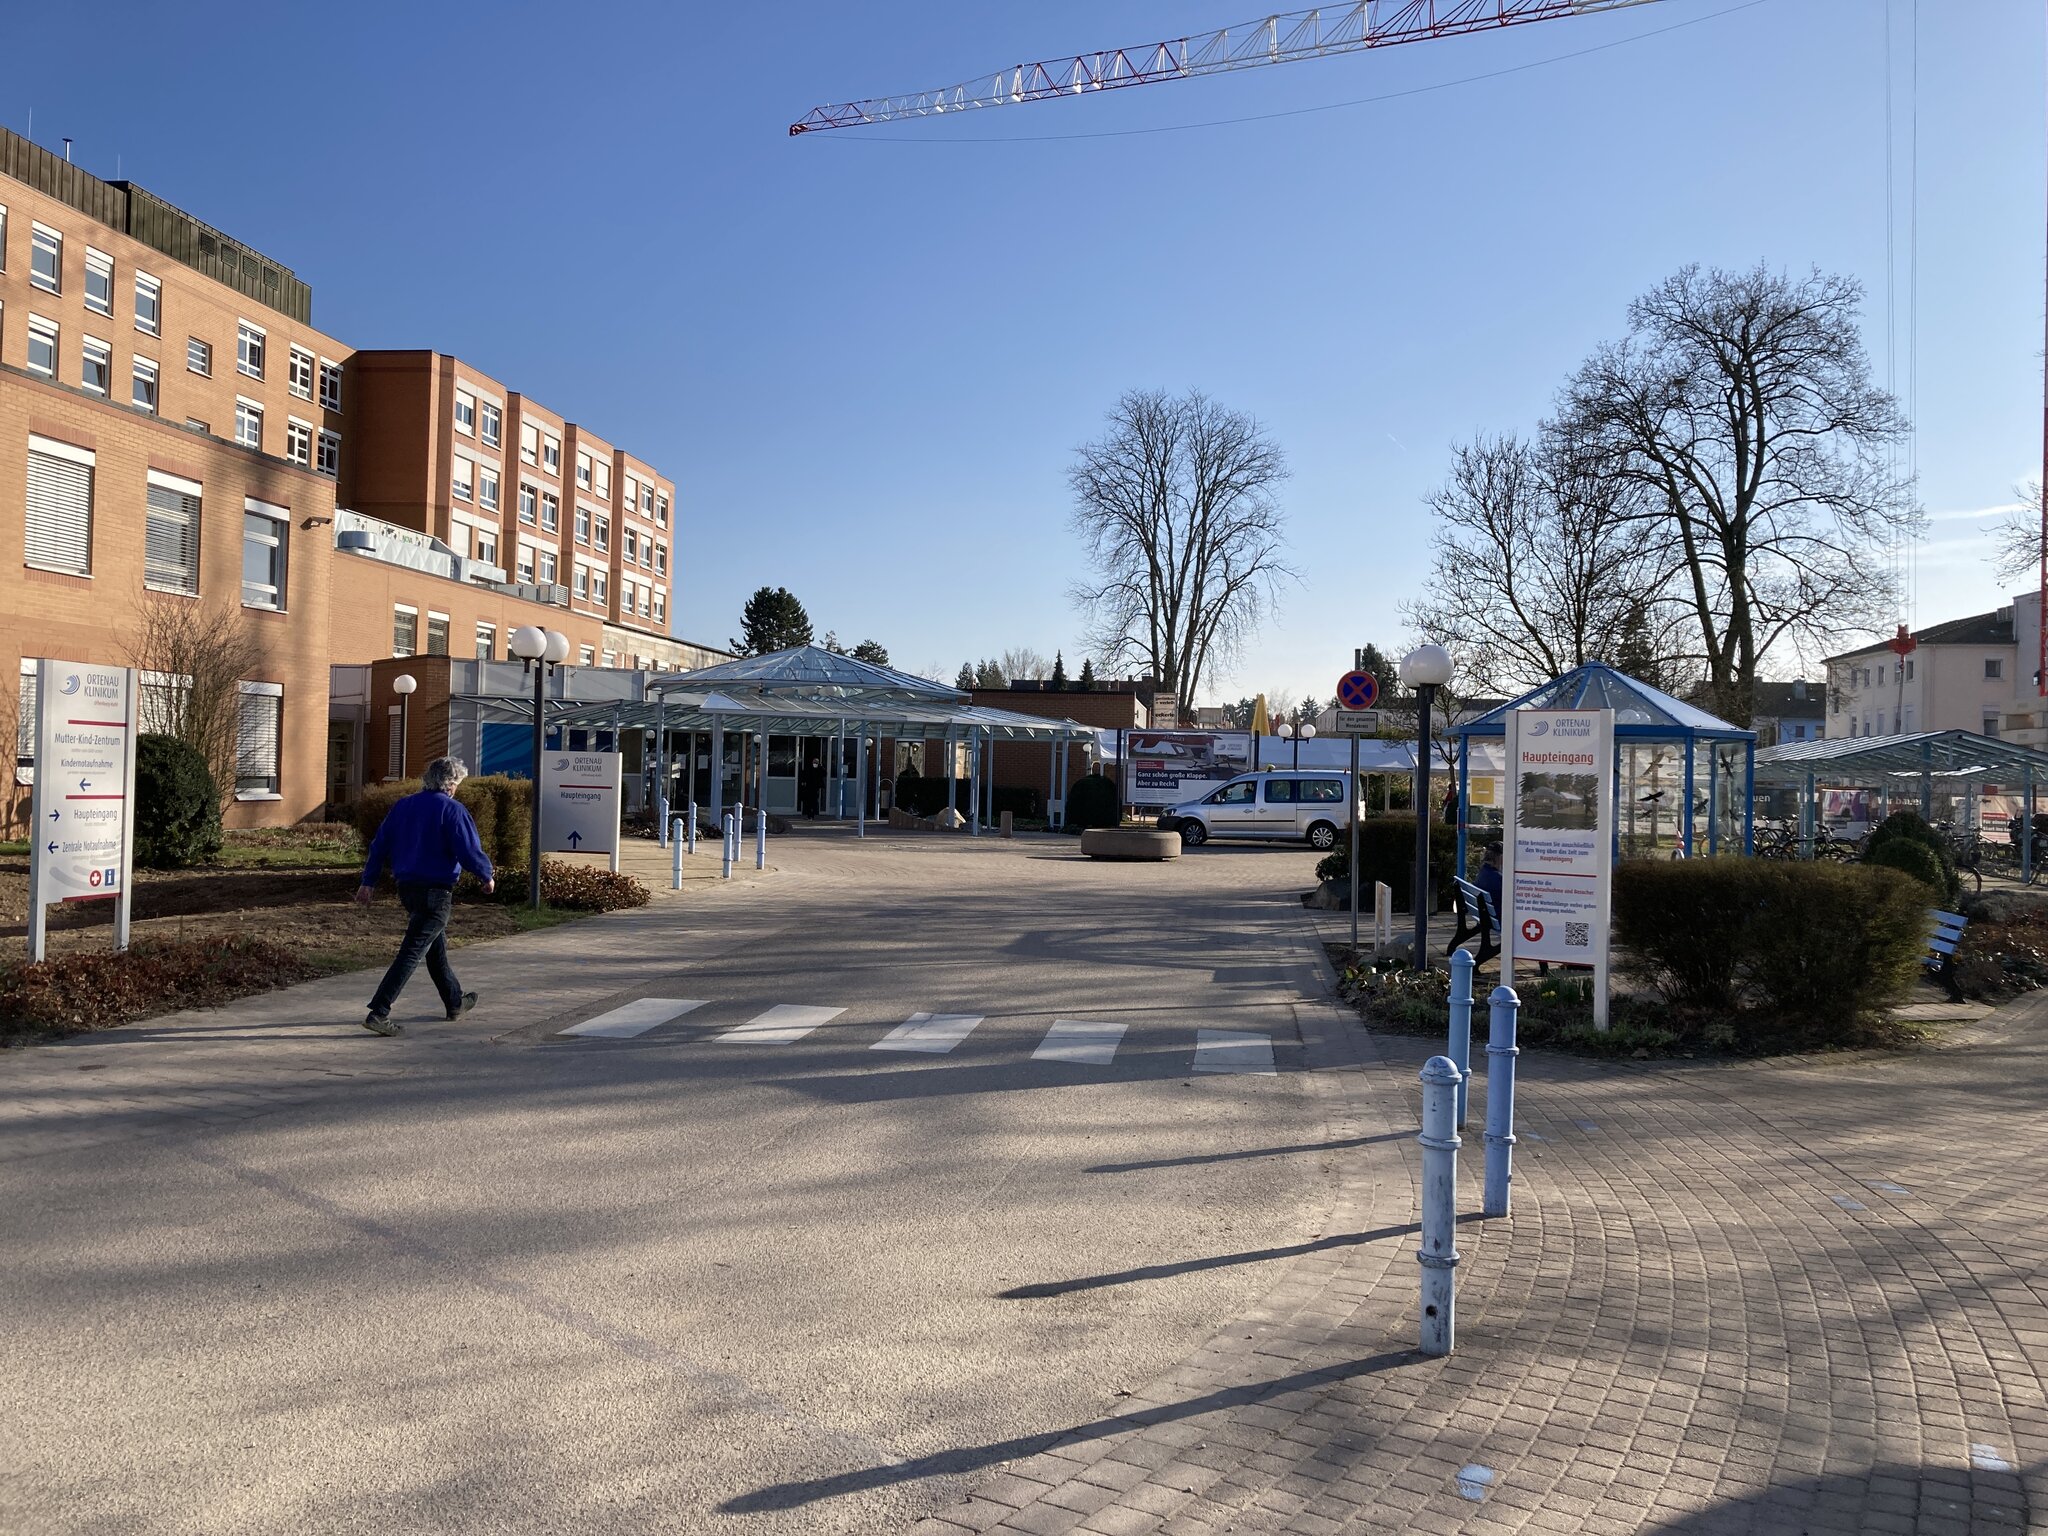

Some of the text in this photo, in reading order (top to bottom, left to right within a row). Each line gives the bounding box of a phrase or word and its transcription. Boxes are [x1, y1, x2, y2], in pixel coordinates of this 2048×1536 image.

[86, 673, 120, 687] ORTENAU
[84, 686, 119, 699] KLINIKUM
[1555, 719, 1591, 727] ORTENAU
[1553, 728, 1590, 736] KLINIKUM
[54, 733, 121, 746] Mutter-Kind-Zentrum
[574, 757, 603, 765] ORTENAU
[1522, 751, 1594, 765] Haupteingang
[60, 759, 114, 768] Kindernotaufnahme
[1186, 772, 1208, 780] Klappe.
[560, 792, 602, 802] Haupteingang
[73, 808, 118, 821] Haupteingang
[62, 838, 117, 853] Zentrale Notaufnahme
[1539, 855, 1573, 863] Haupteingang
